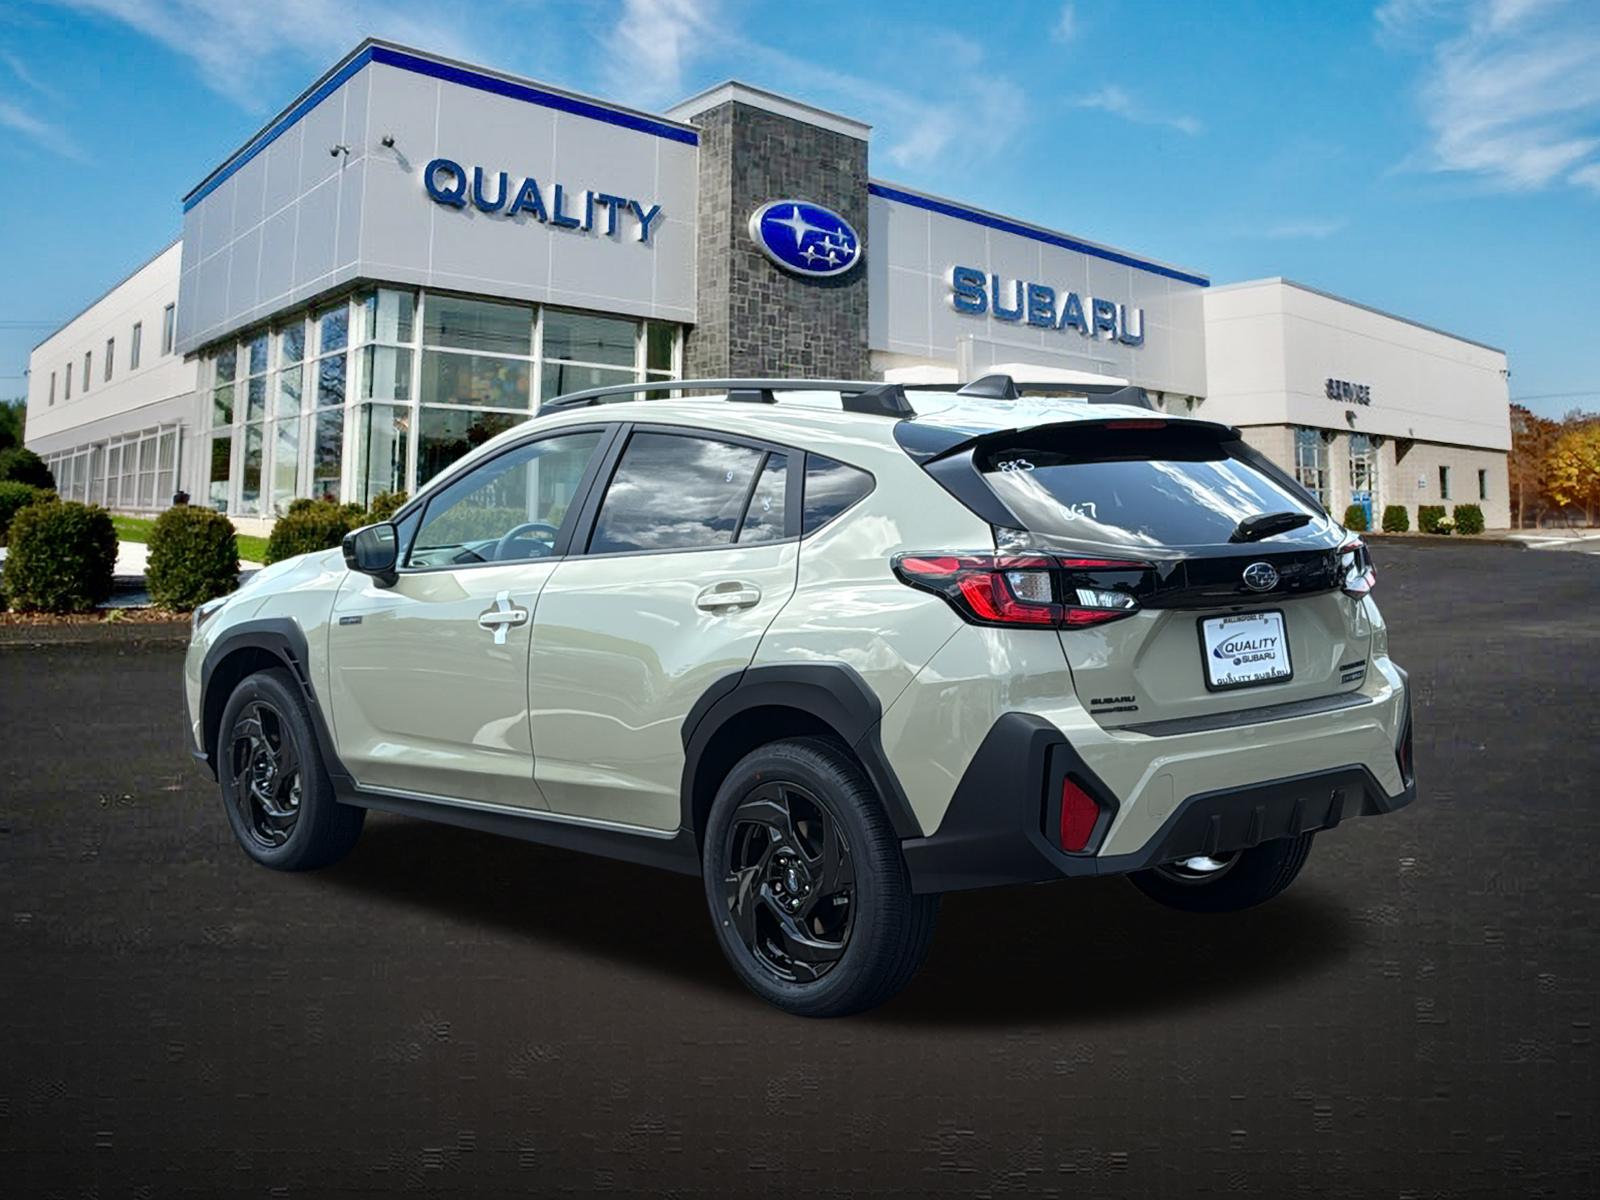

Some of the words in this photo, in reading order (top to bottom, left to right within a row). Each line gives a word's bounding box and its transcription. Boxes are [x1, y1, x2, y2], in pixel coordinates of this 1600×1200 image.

[423, 158, 662, 243] QUALITY
[948, 265, 1145, 347] SUBARU
[1324, 378, 1370, 406] SERVICE
[1224, 637, 1278, 654] QUALITY
[1241, 652, 1276, 664] SUBARU
[1217, 674, 1252, 686] QUALITY
[1254, 669, 1289, 680] SUBARU
[1091, 696, 1136, 705] SUBARU
